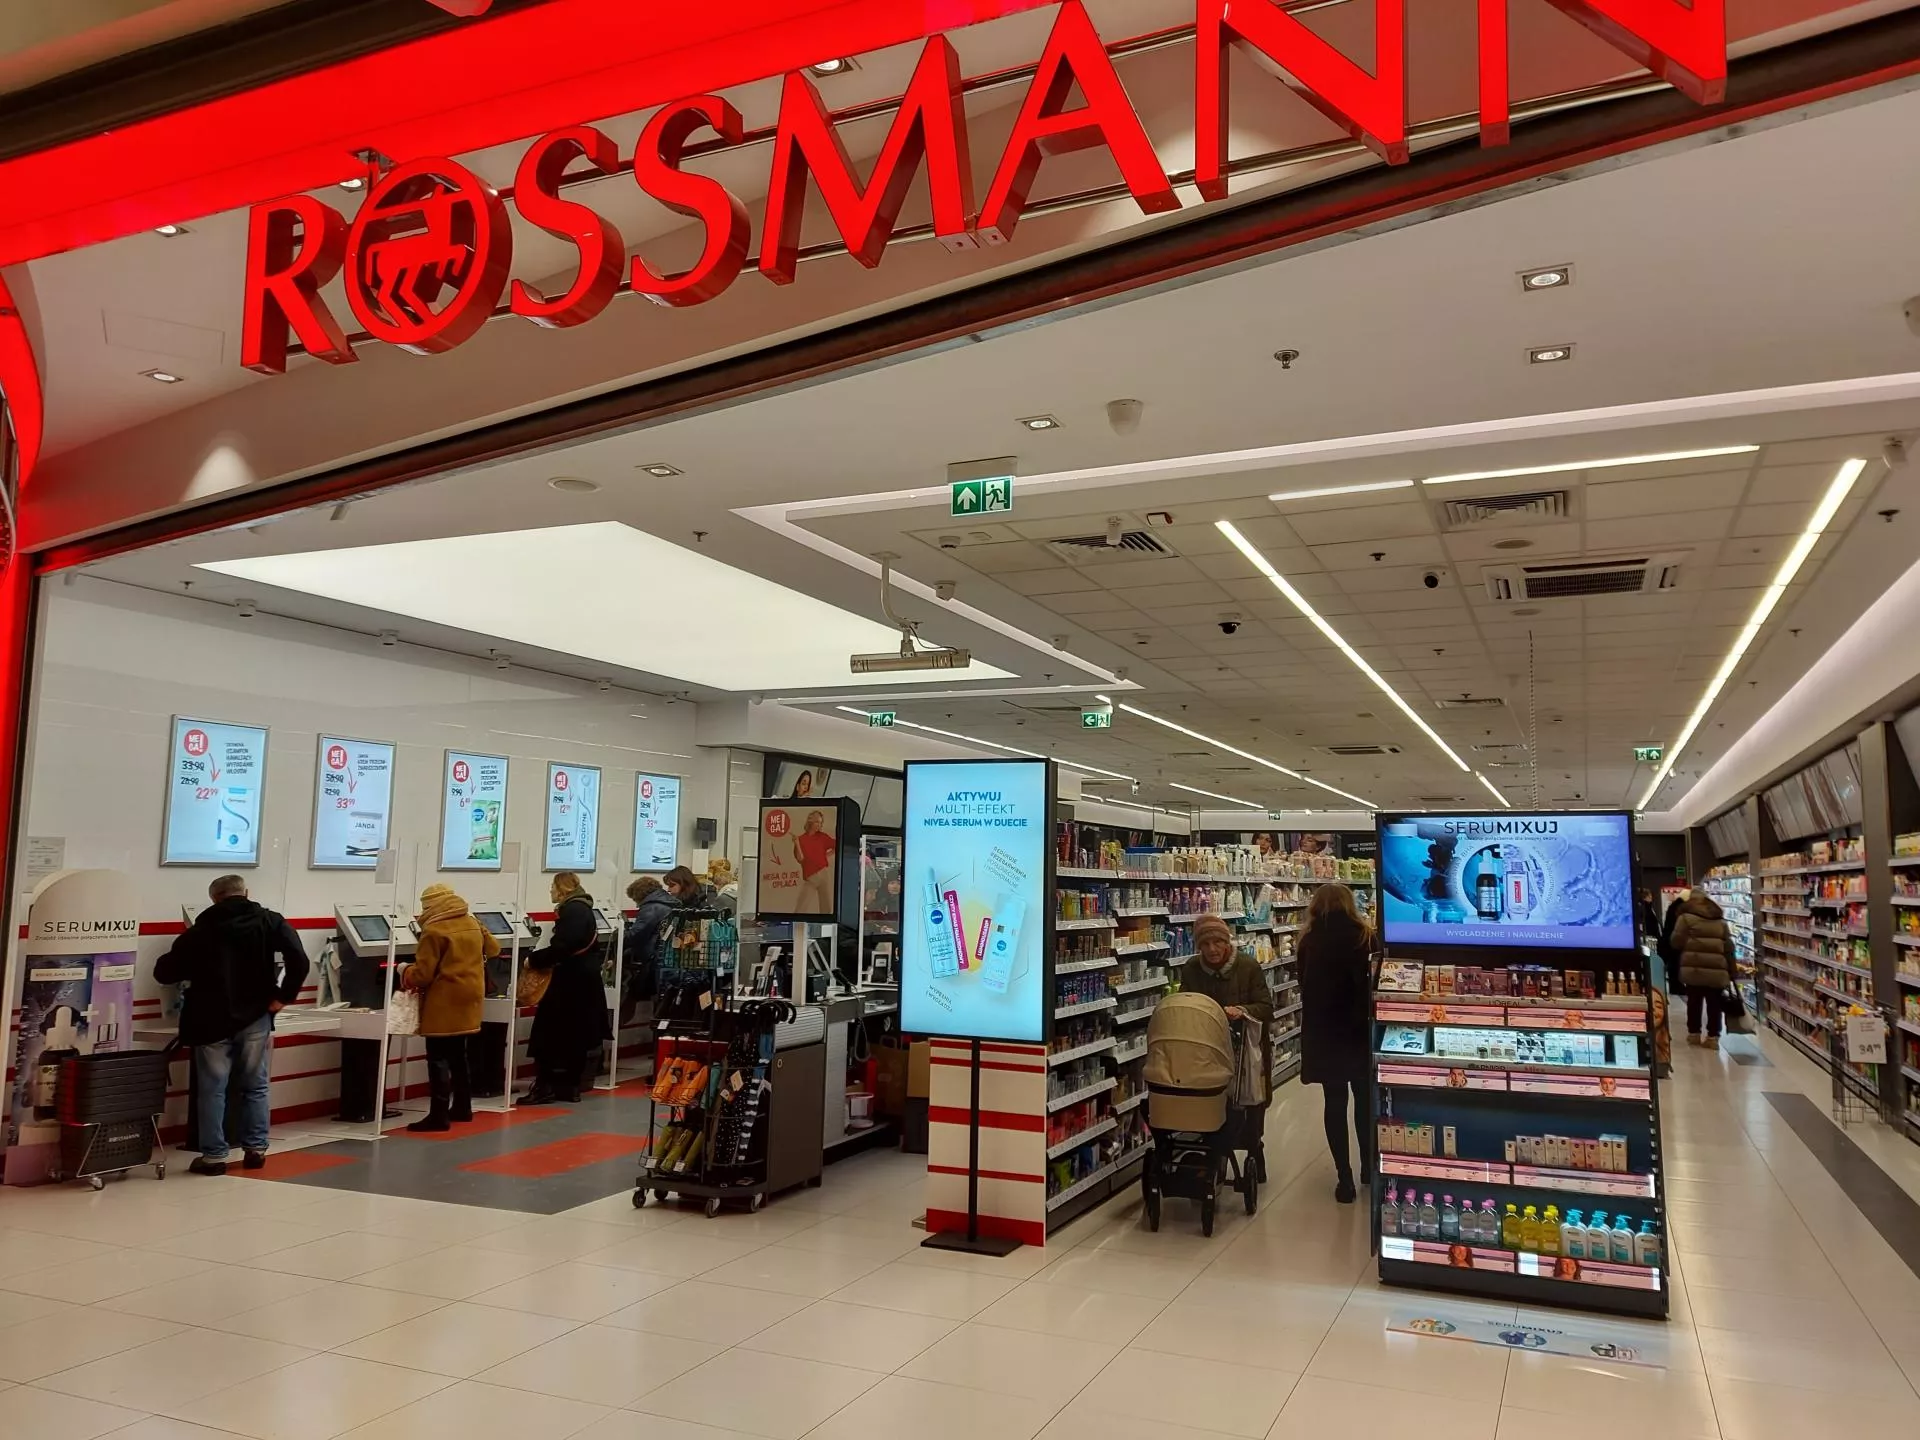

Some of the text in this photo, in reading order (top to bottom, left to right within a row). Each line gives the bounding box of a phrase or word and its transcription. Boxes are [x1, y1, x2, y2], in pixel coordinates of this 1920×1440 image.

[241, 0, 1728, 374] ROSSMANN
[947, 791, 1001, 801] AKTYWUJ
[934, 804, 1016, 814] MULTI-EFEKT
[924, 818, 1028, 827] NIVEA SERUM W DUECIE
[1444, 821, 1558, 834] SERUMIXUJ
[579, 812, 588, 859] SENSODYNE
[43, 920, 136, 933] SERUMIXUJ
